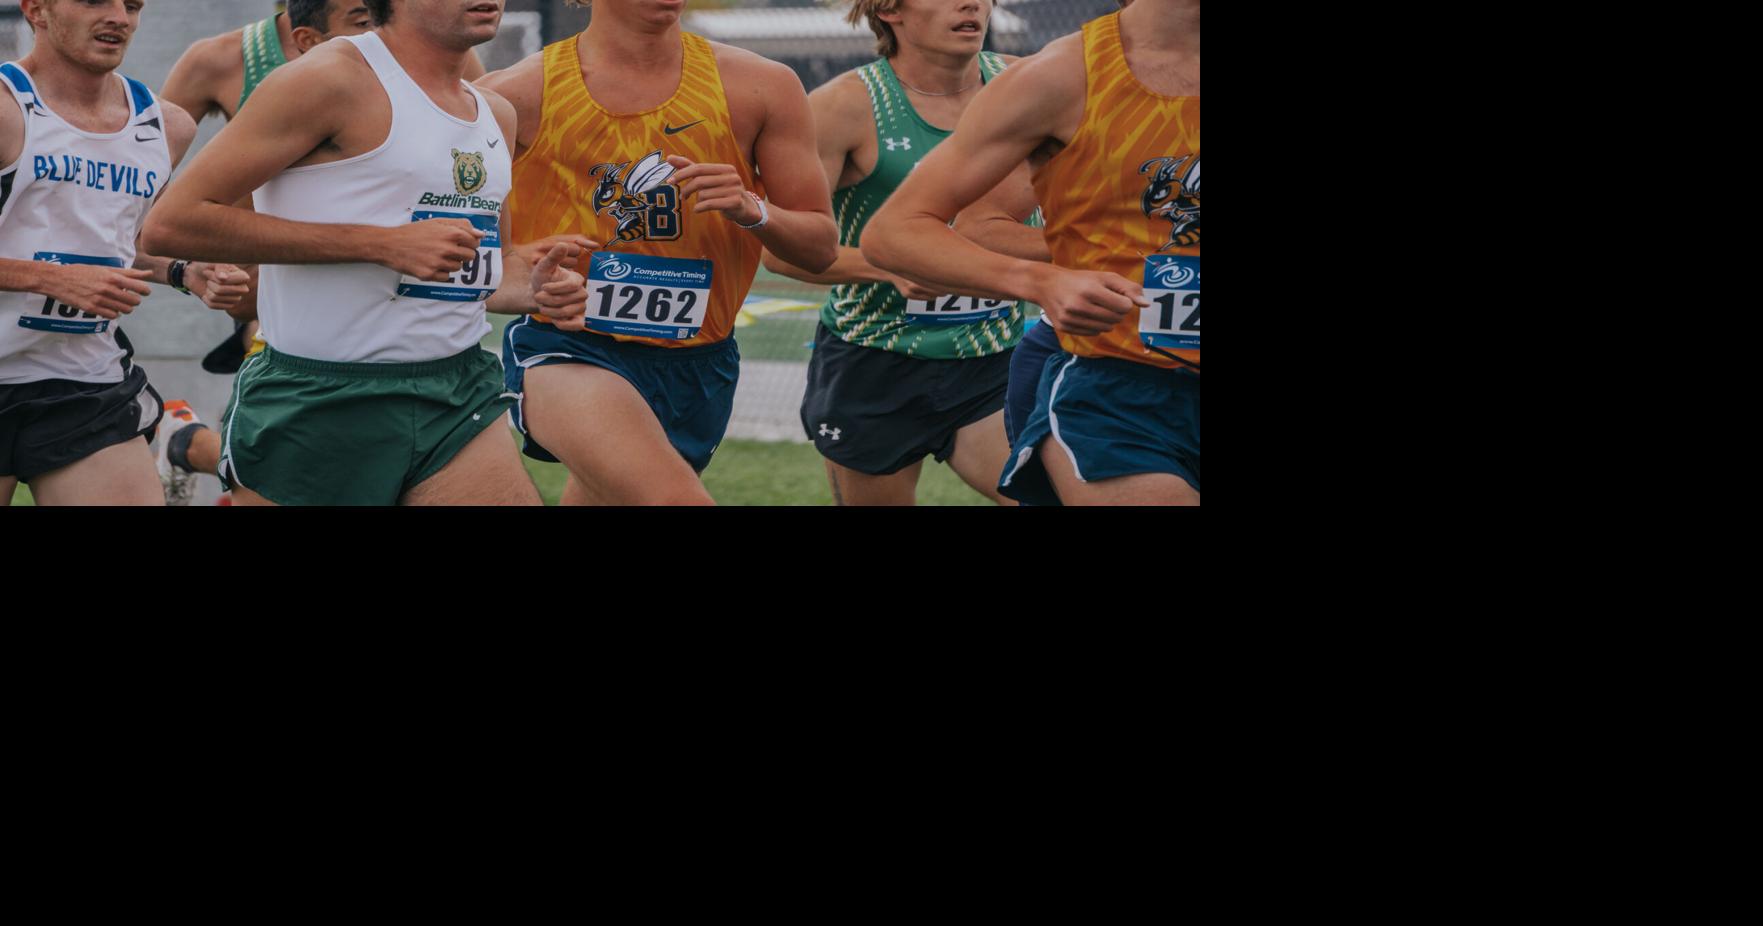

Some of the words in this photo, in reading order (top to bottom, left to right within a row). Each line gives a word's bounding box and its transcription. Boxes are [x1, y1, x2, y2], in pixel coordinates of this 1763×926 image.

[33, 154, 82, 185] BLUE
[86, 159, 157, 199] DEVILS
[447, 247, 493, 286] 91
[596, 284, 697, 324] 1262
[1153, 292, 1200, 331] 12
